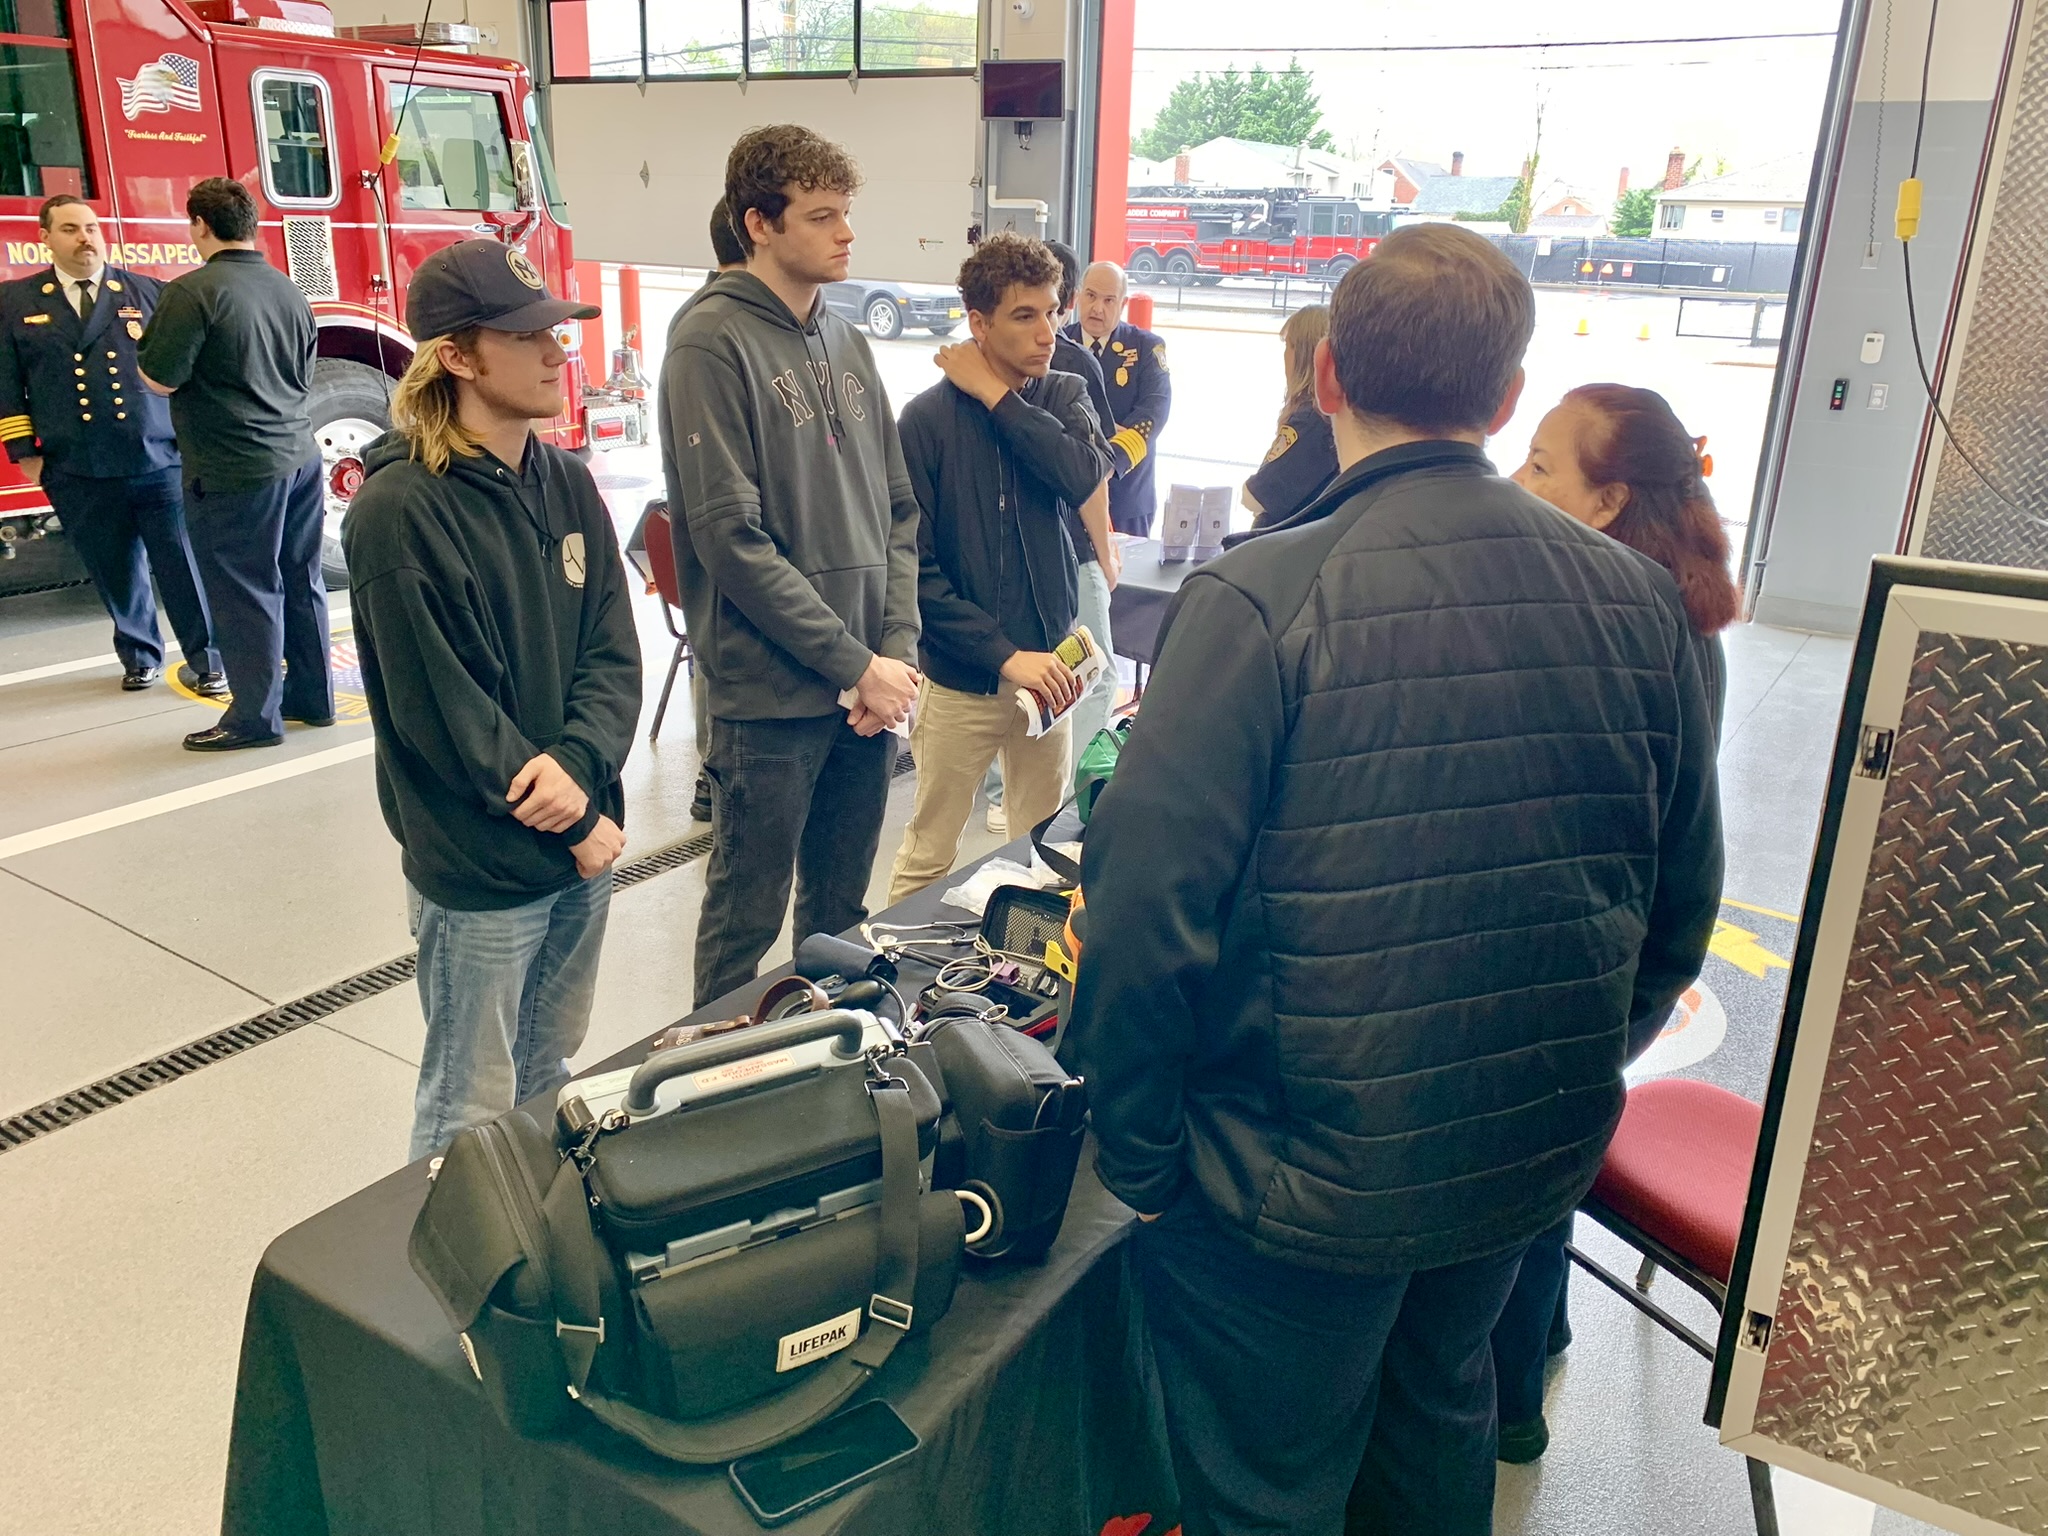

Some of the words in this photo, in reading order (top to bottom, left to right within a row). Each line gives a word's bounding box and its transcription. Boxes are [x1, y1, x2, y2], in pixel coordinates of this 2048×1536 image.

[158, 131, 173, 141] And
[1150, 209, 1180, 218] COMPANY
[6, 242, 53, 265] NOR
[104, 243, 203, 265] ASSAPEQ
[772, 360, 866, 428] NYC
[790, 1325, 848, 1357] LIFEPAK
